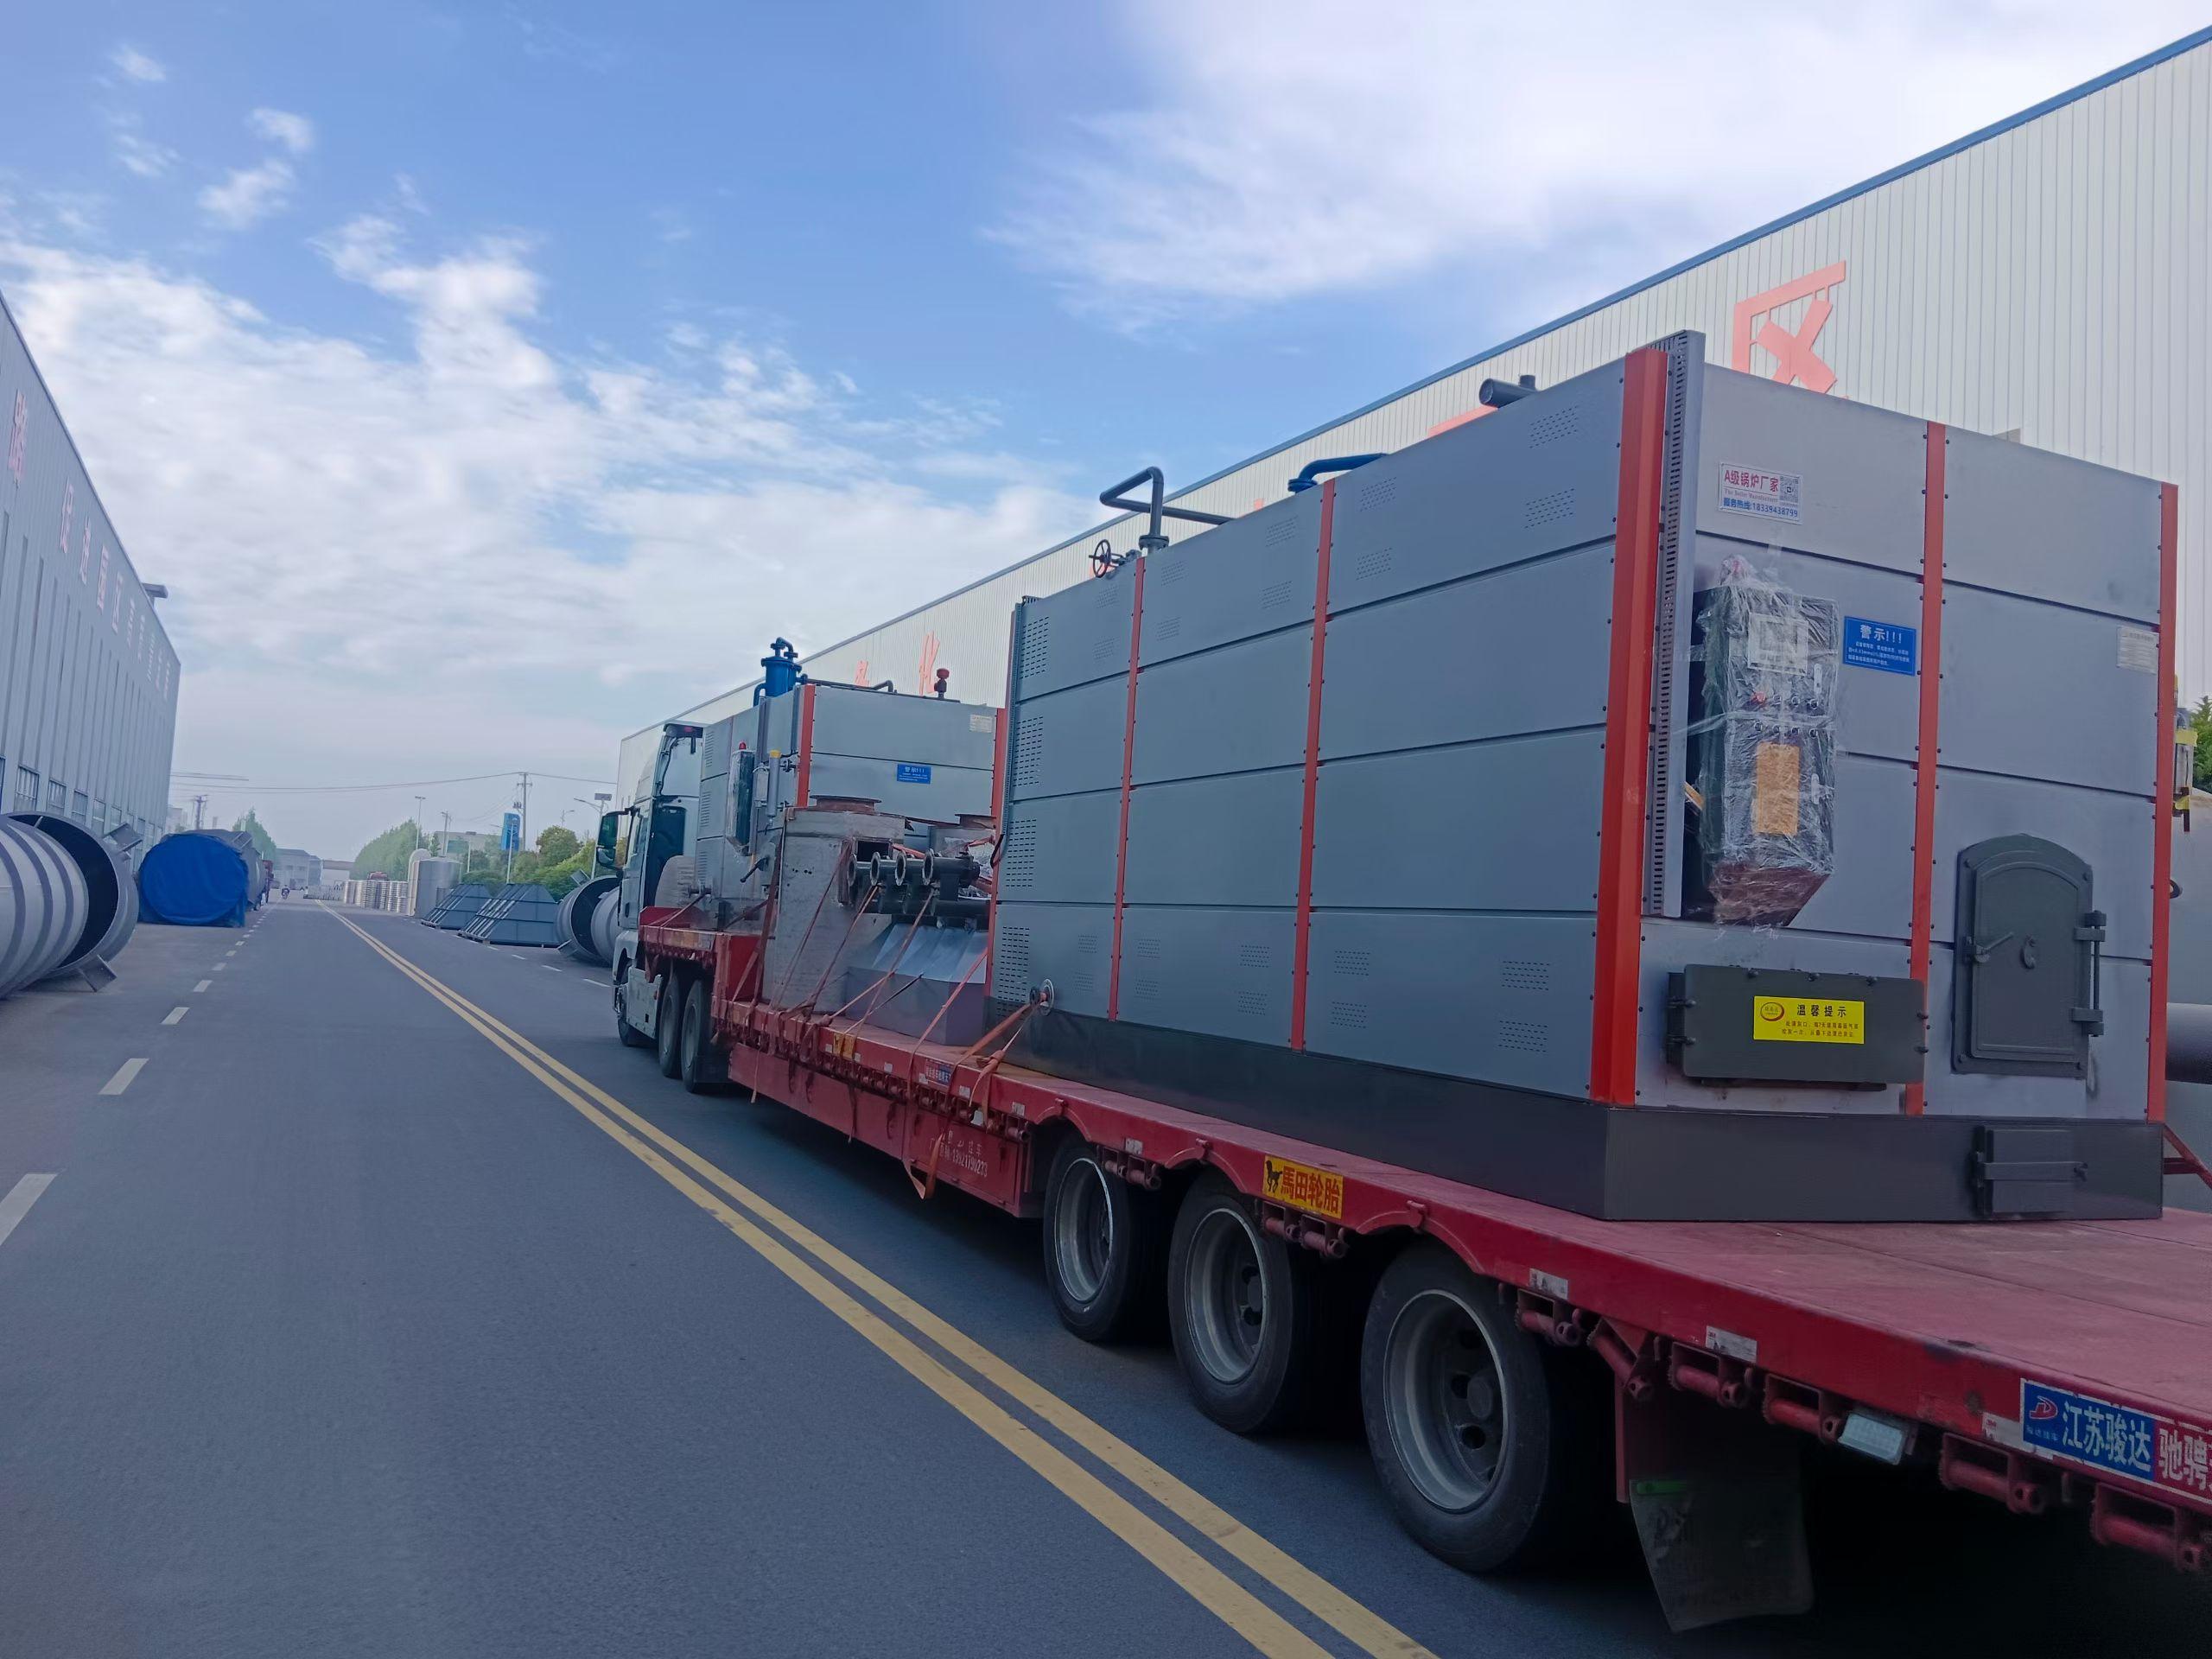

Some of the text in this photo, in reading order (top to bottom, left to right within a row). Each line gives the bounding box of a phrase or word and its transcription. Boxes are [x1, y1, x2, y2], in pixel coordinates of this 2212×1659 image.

[1724, 469, 1779, 493] A级锅炉厂家
[1796, 1004, 1847, 1018] 温馨提示
[1281, 1166, 1340, 1213] 馬田轮胎
[2062, 1400, 2212, 1491] 江苏骏达 驰骋
